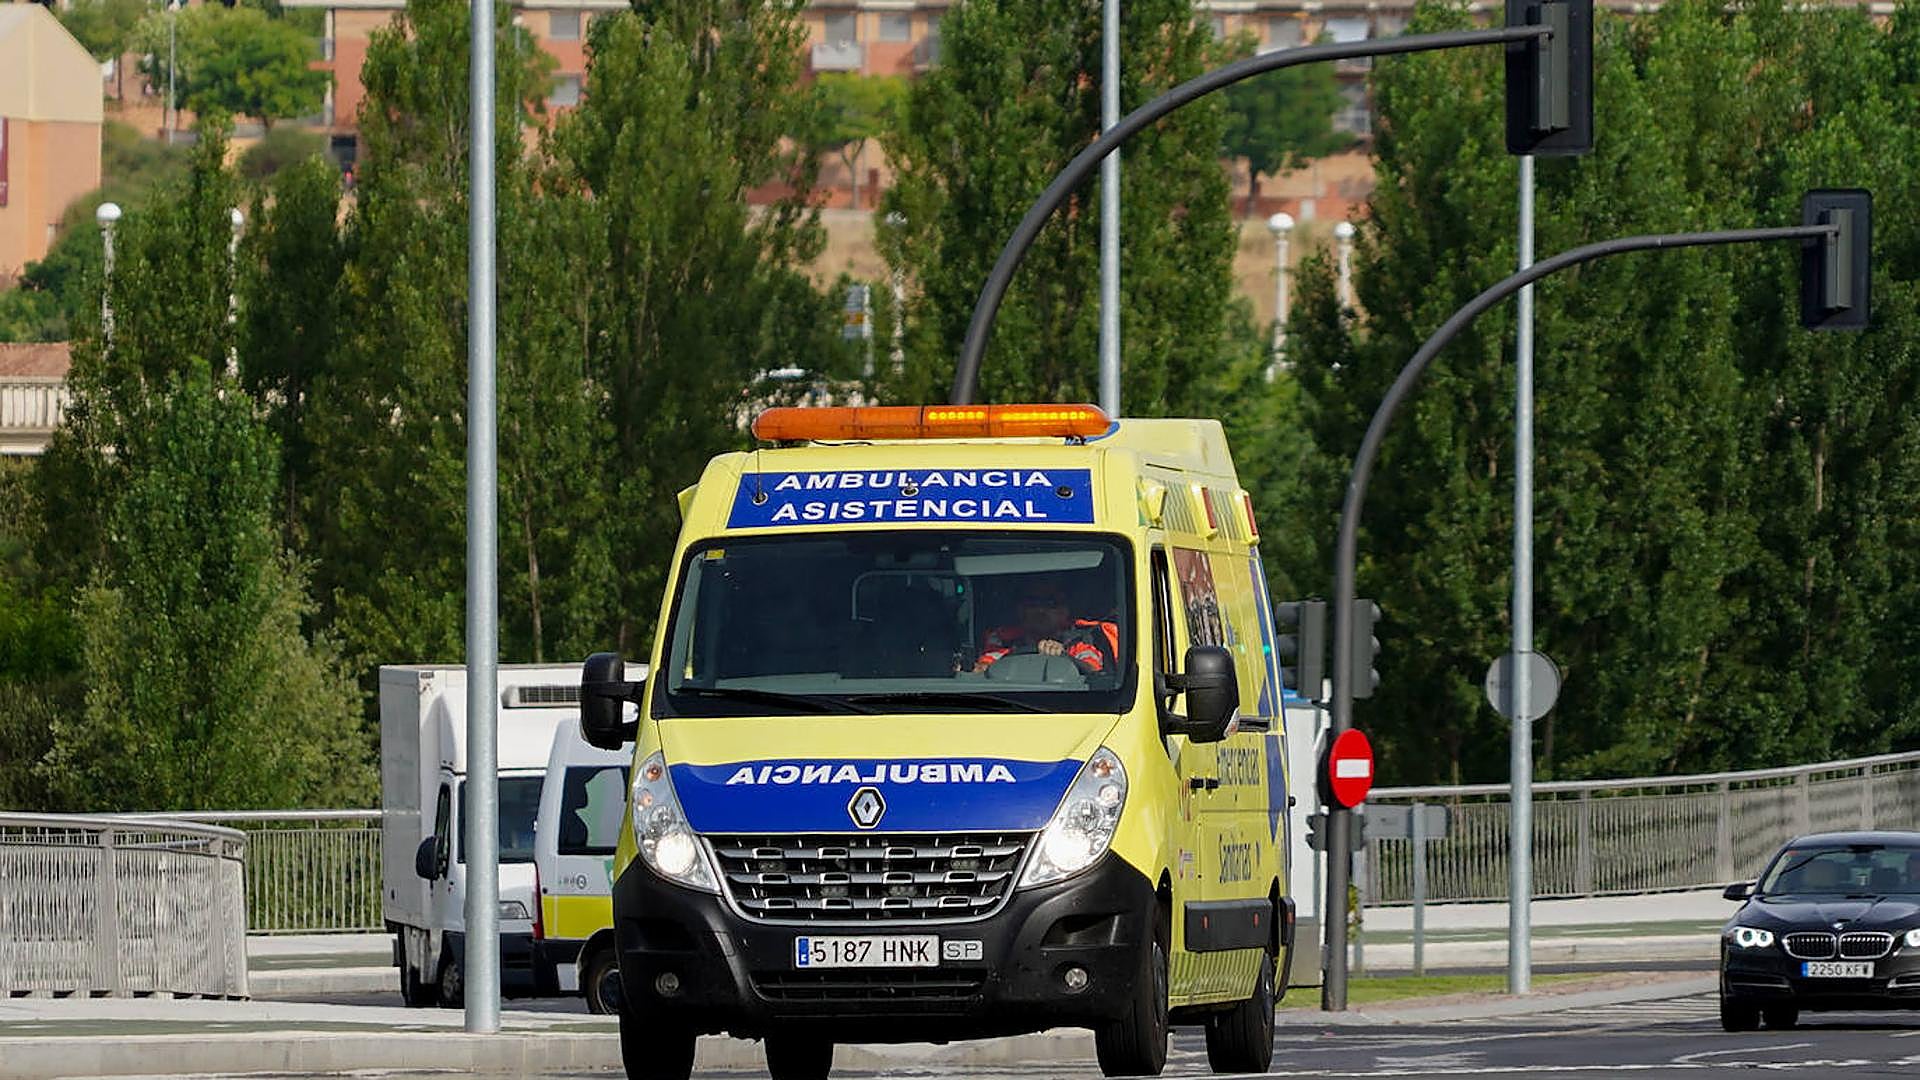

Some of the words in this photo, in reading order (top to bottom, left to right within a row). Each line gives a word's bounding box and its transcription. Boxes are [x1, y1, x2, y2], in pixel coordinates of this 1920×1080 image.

[774, 471, 1053, 491] AMBULANCIA
[771, 500, 1048, 521] ASISTENCIAL
[814, 940, 872, 962] 5187
[883, 940, 929, 962] HNK
[946, 942, 979, 958] SP
[1811, 963, 1843, 976] 2250
